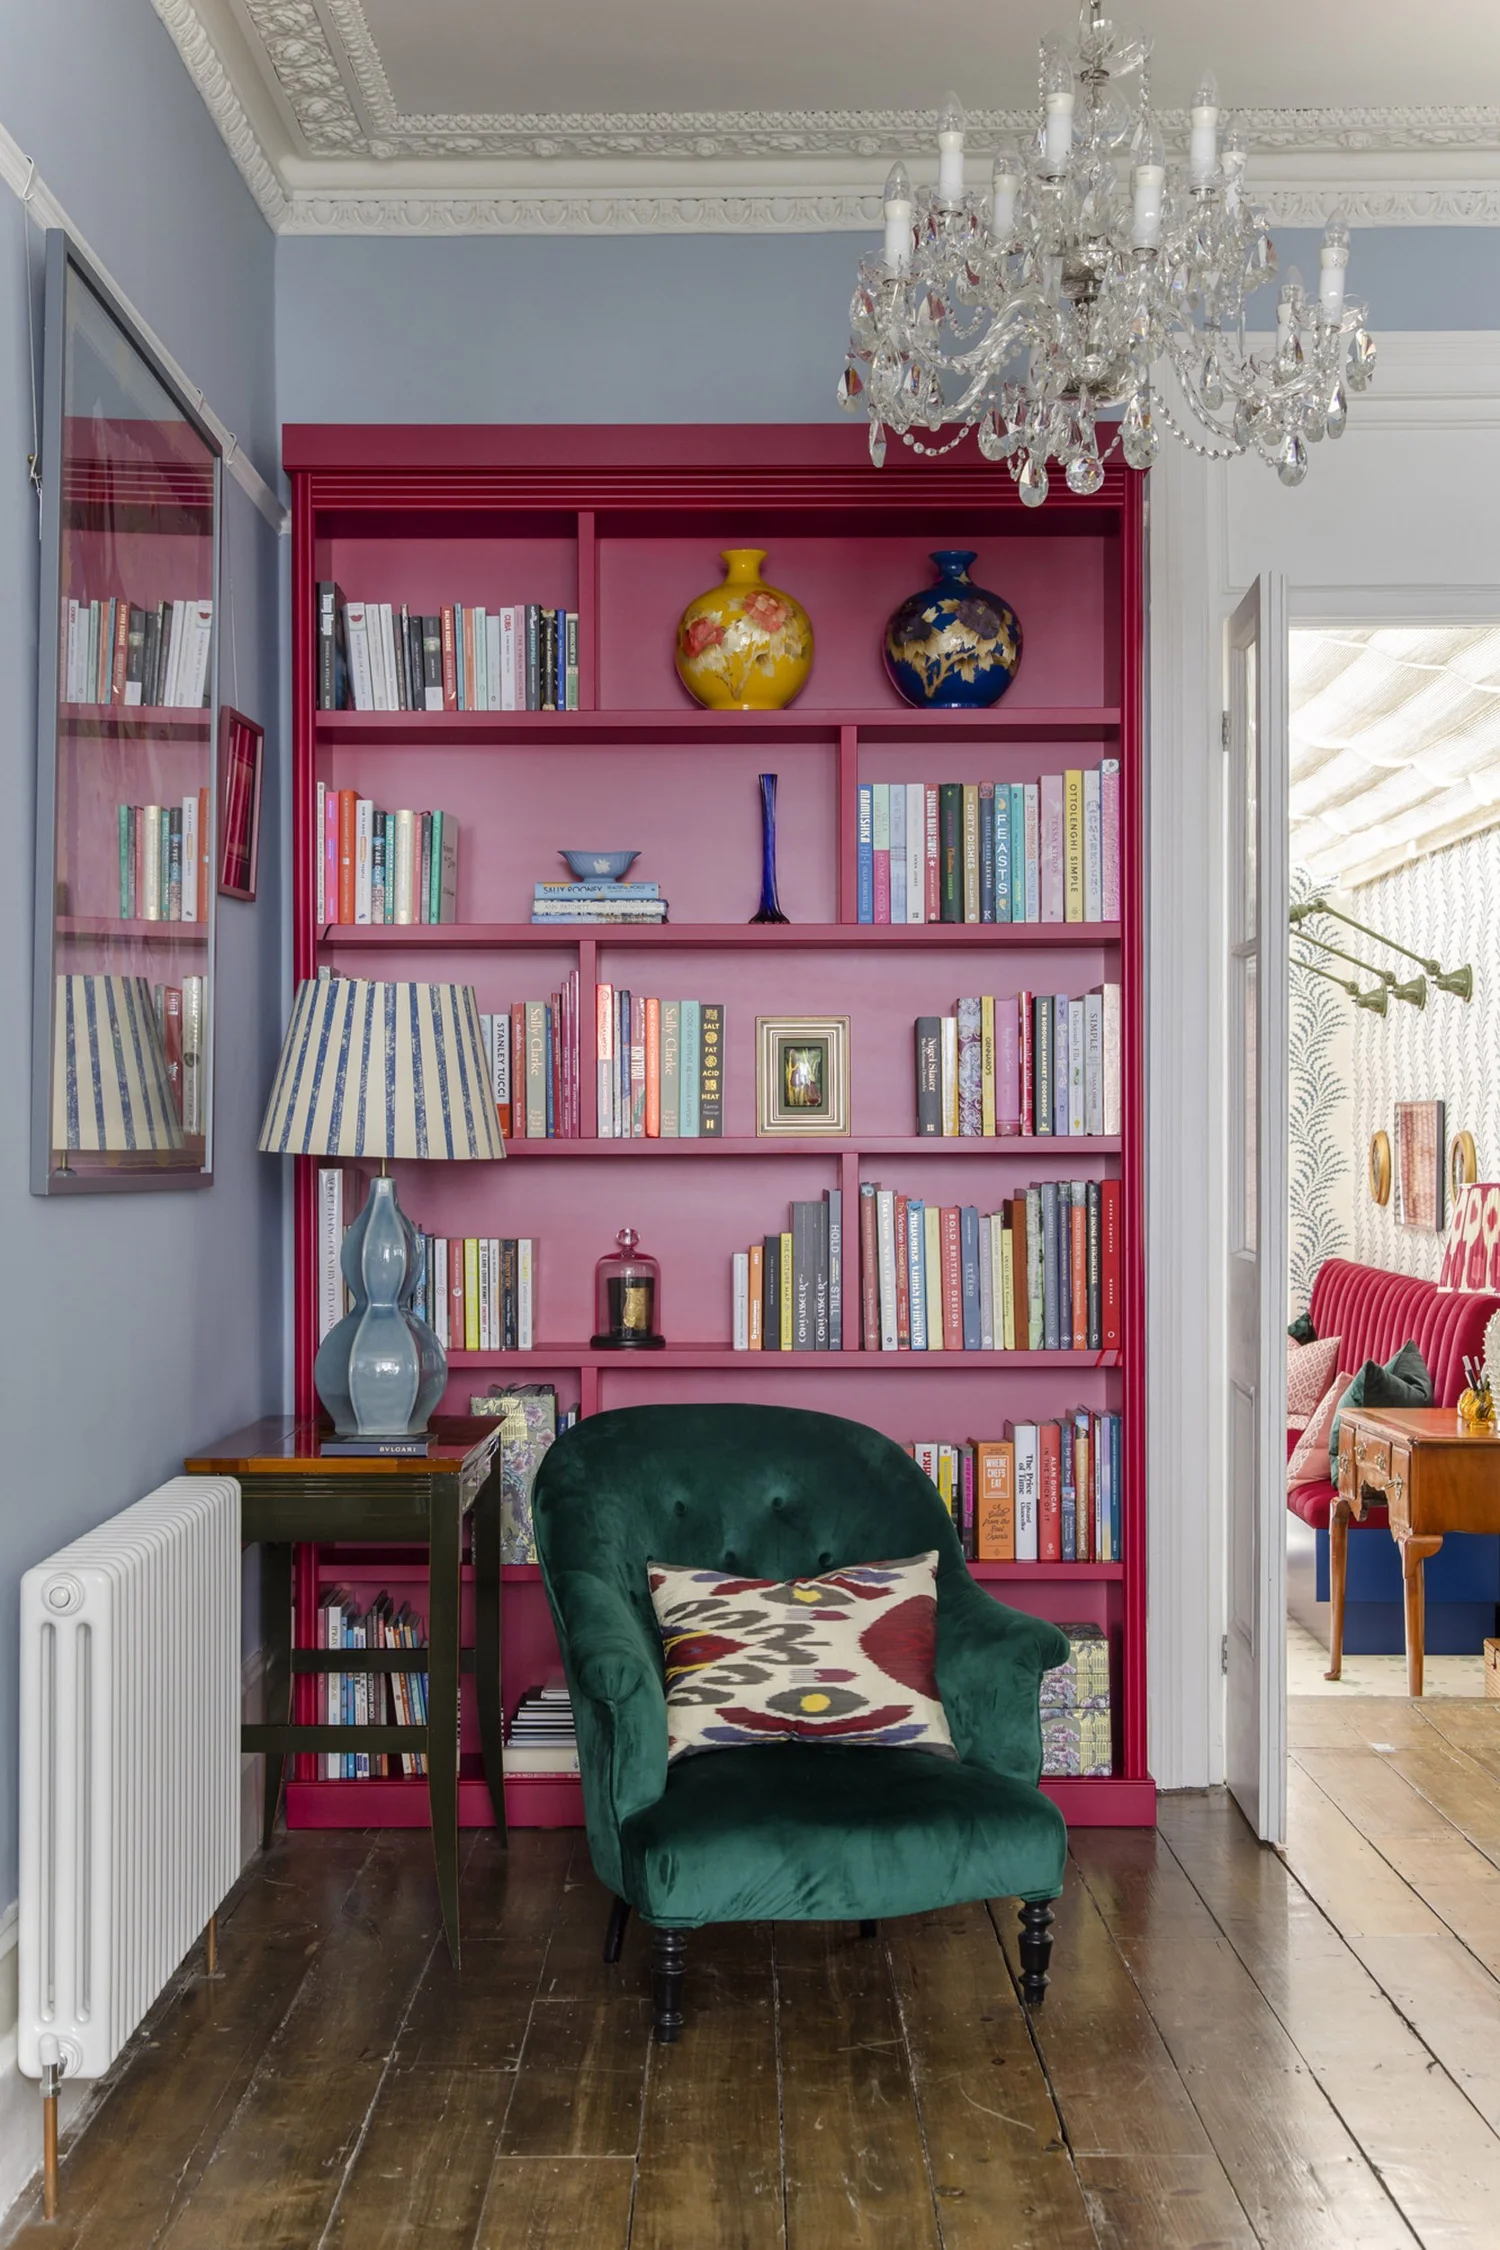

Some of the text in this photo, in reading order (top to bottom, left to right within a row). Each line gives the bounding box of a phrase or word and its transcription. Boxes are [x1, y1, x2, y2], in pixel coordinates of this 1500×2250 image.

[504, 614, 512, 632] CUBA
[860, 790, 870, 843] MAMUSHKA
[966, 804, 975, 832] DIRTY
[966, 834, 976, 870] DISHES
[996, 814, 1008, 896] FEASTS
[1050, 814, 1060, 874] TESSA KIROS
[1069, 783, 1078, 894] OTTOLENGHI SIMPLE
[542, 886, 602, 894] SALLY ROONEY
[878, 852, 886, 912] HOME FOOD
[526, 1008, 542, 1076] Sally Clarke
[662, 1008, 678, 1076] Sally Clarke
[703, 1022, 720, 1030] SALT
[1072, 1010, 1080, 1046] Deliciously
[1090, 1012, 1099, 1050] SIMPLE
[496, 1022, 506, 1098] STANLEY TUCCI
[631, 1046, 644, 1060] KIN
[927, 1036, 938, 1092] Nigel Slater
[631, 1061, 644, 1080] THAI
[948, 1214, 956, 1240] BOLD
[1090, 1206, 1098, 1216] AT
[898, 1213, 906, 1244] Victorian
[503, 1250, 514, 1289] Tangerine
[830, 1224, 840, 1316] HOLD STILL
[898, 1244, 906, 1266] House
[950, 1245, 958, 1286] BRITISH
[1044, 1446, 1050, 1455] IN
[1064, 1447, 1072, 1456] by
[1018, 1462, 1026, 1495] of Time
[1044, 1502, 1050, 1512] OF
[1044, 1514, 1050, 1522] IT
